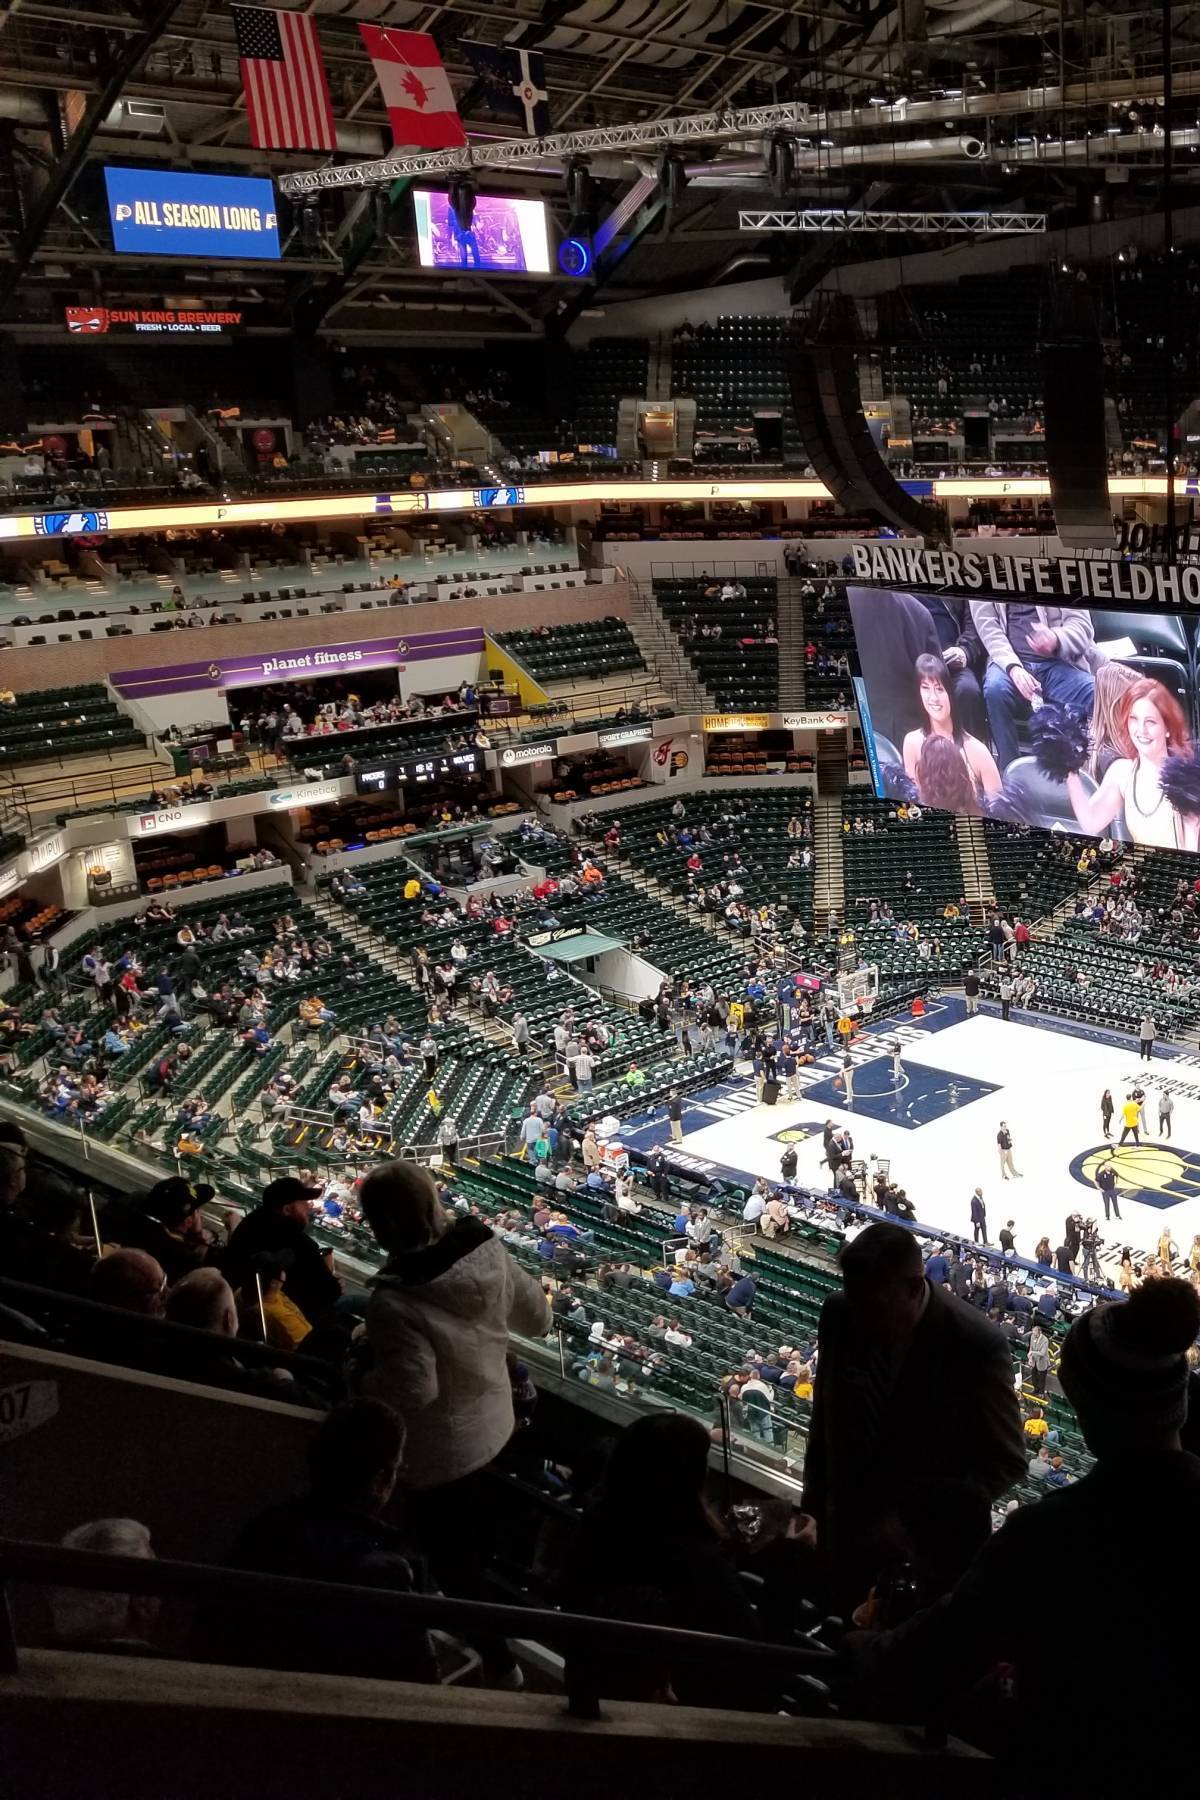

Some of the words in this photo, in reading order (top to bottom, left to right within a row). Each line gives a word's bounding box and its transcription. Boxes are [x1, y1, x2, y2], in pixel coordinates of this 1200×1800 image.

[135, 201, 161, 226] ALL
[162, 202, 221, 229] SEASON
[223, 206, 262, 231] LONG
[110, 311, 139, 322] SUN
[142, 311, 175, 323] KING
[178, 312, 242, 324] BREWERY
[135, 323, 162, 331] FRESH
[201, 324, 222, 332] BEER
[852, 544, 983, 588] BANKERS
[989, 555, 1053, 593] LIFE
[263, 654, 311, 674] planet
[315, 650, 362, 666] fitness
[705, 717, 729, 729] HOME
[783, 716, 825, 725] KeyBank
[599, 732, 621, 743] SPORT
[621, 727, 652, 738] GRAPHICS
[515, 745, 552, 759] motorola
[296, 784, 337, 799] Kinetico
[158, 811, 182, 823] CNO
